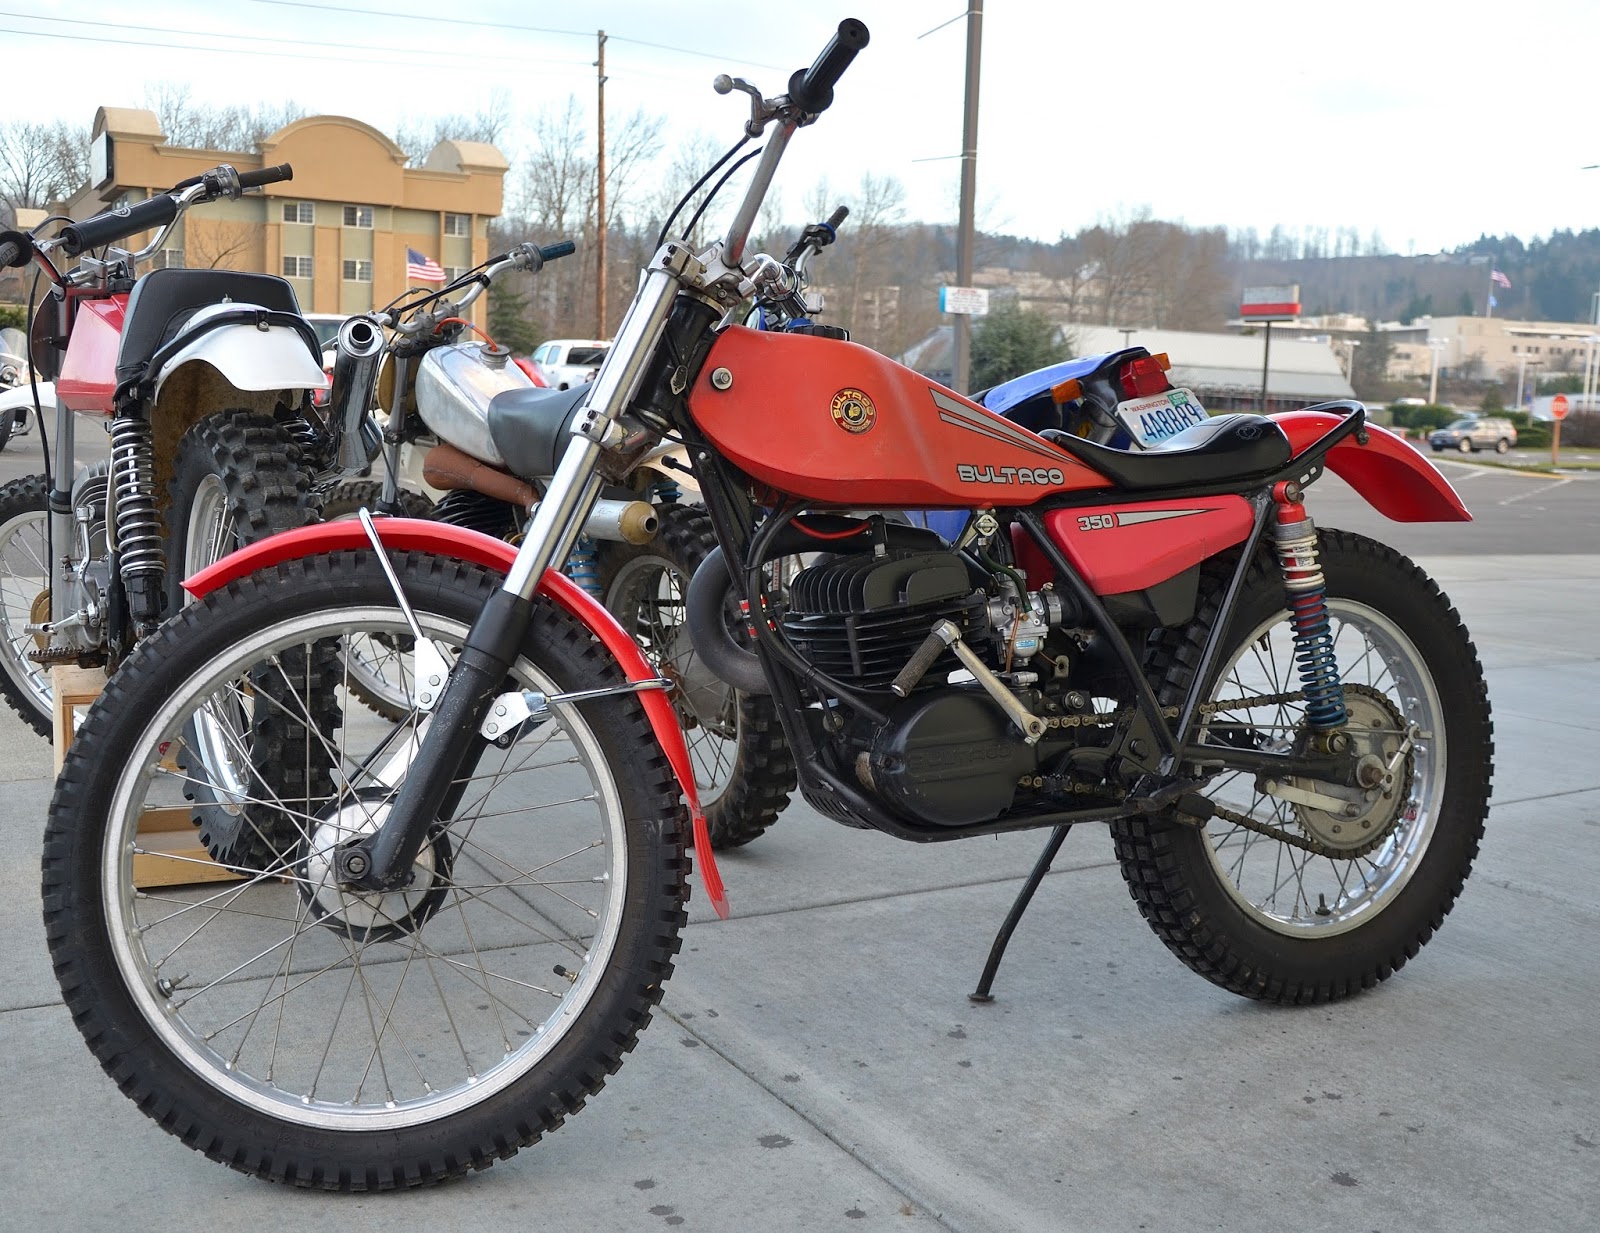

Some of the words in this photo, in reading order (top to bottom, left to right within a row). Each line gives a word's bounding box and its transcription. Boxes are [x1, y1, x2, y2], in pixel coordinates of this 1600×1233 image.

[833, 391, 874, 419] BULTACO
[1130, 400, 1170, 412] WASHINGTON
[1552, 401, 1569, 412] STOP
[957, 464, 1064, 485] BULTACO
[1077, 514, 1113, 531] 350
